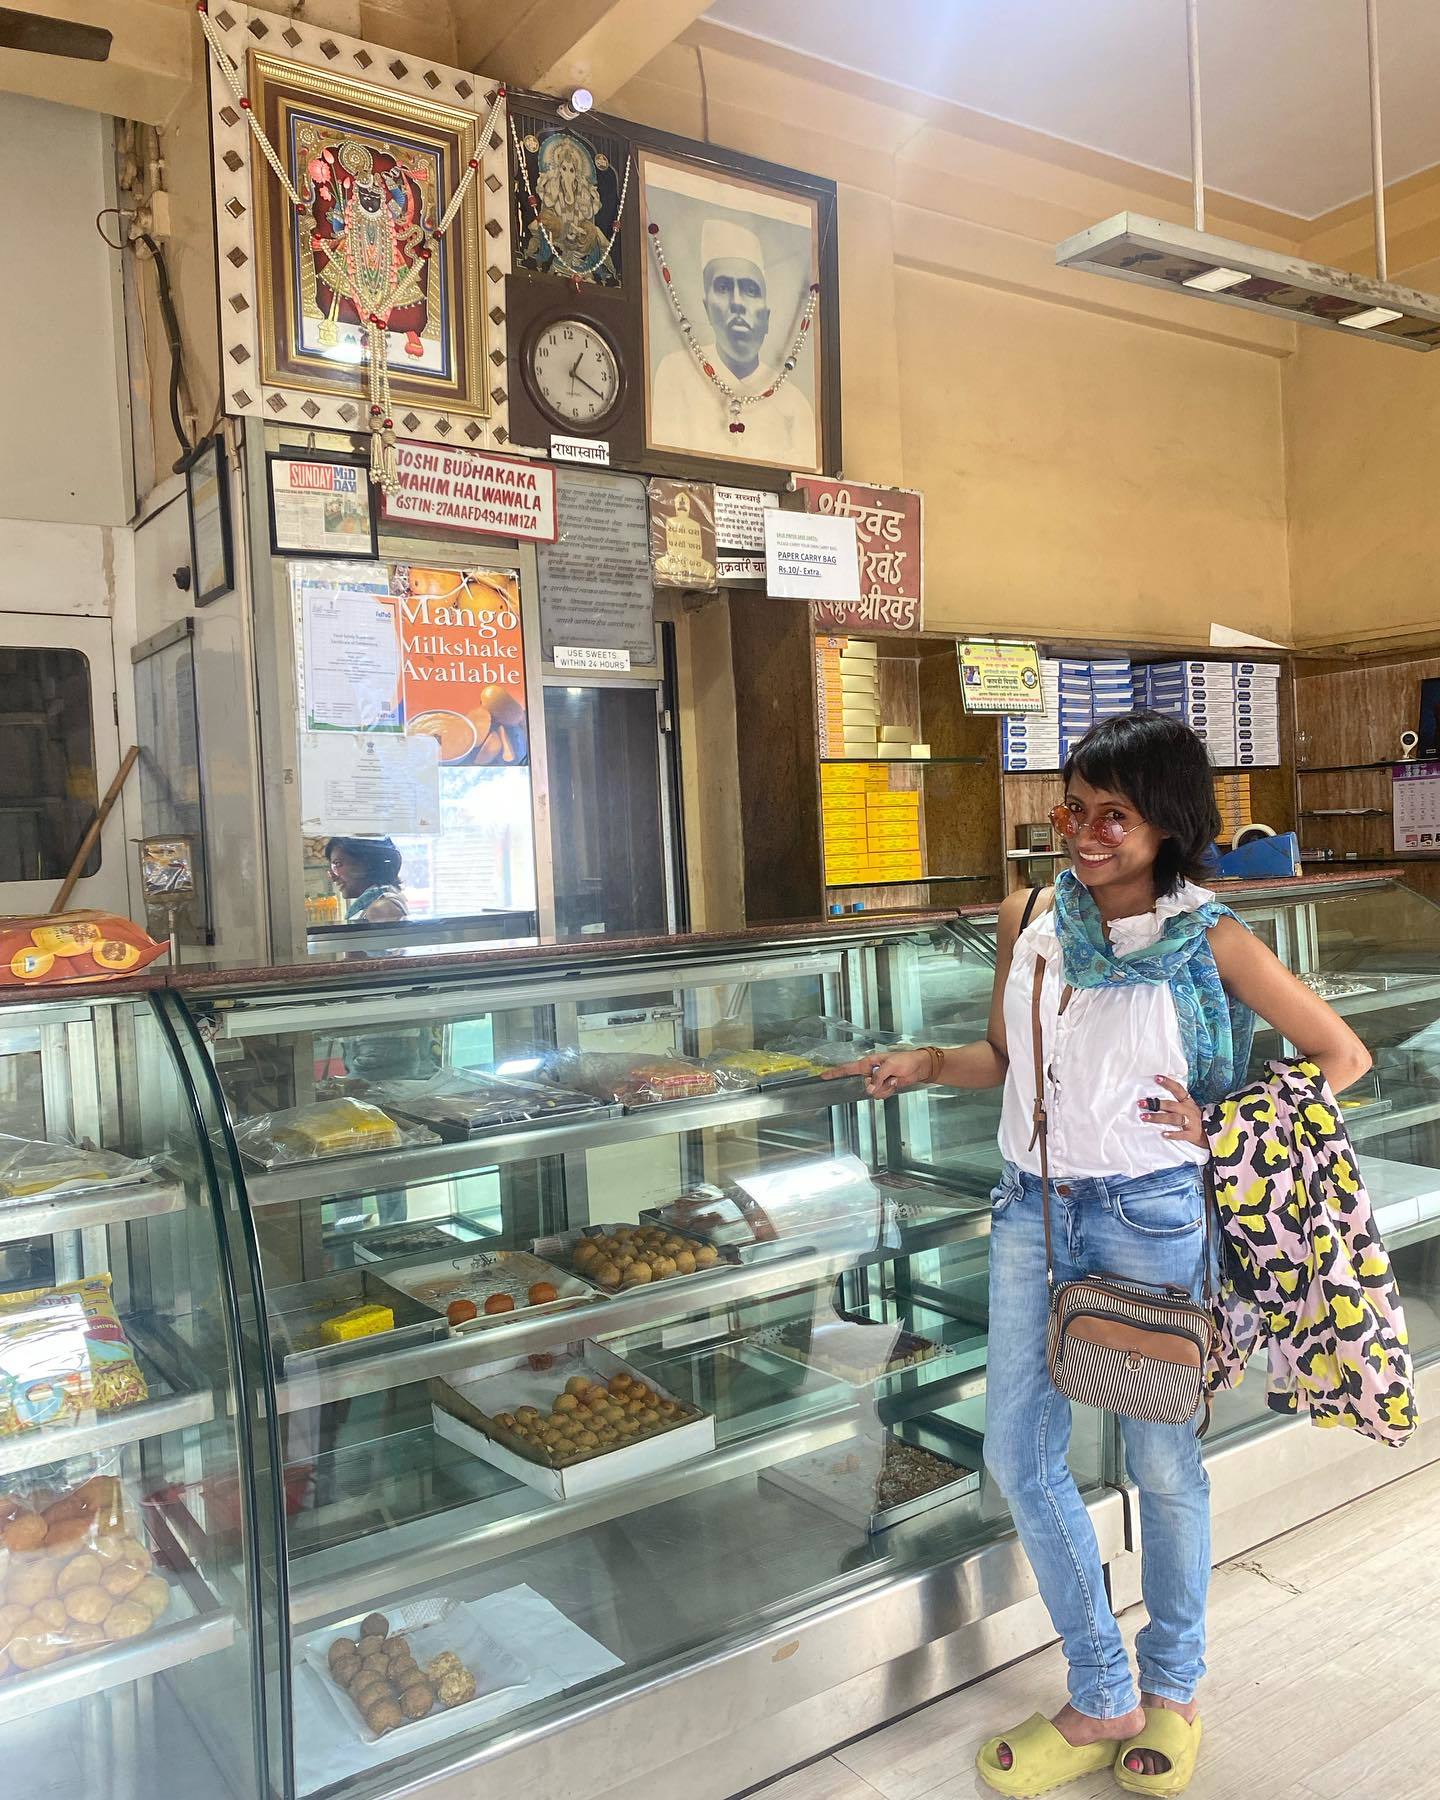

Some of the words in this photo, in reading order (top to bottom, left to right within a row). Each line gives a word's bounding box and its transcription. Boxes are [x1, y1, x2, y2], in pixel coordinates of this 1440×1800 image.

[549, 335, 557, 345] 11
[563, 330, 574, 340] 12
[584, 338, 589, 349] 1
[538, 347, 549, 358] 10
[595, 352, 602, 362] 2
[535, 366, 542, 376] 9
[601, 371, 607, 382] 3
[556, 402, 562, 411] 7
[588, 403, 595, 413] 5
[572, 408, 579, 418] 6
[554, 442, 607, 461] राधास्वामी
[395, 448, 439, 472] JOSHI
[443, 457, 537, 491] BUDHAKAKA
[290, 464, 333, 491] SUNDAY
[333, 480, 356, 492] DAY
[396, 471, 449, 496] MAHIM
[453, 481, 542, 512] HALWAWALA
[717, 491, 732, 501] एक
[777, 551, 800, 560] PAPER
[800, 553, 822, 562] CARRY
[822, 556, 837, 564] BAG
[857, 584, 918, 630] श्रीखंड
[400, 598, 518, 639] Mango
[401, 635, 518, 659] Milkshake
[567, 646, 584, 657] USE
[585, 647, 617, 659] SWEETS
[560, 656, 587, 668] WITHIN
[588, 659, 598, 668] 24
[599, 659, 626, 670] HOURS
[402, 659, 521, 684] Available
